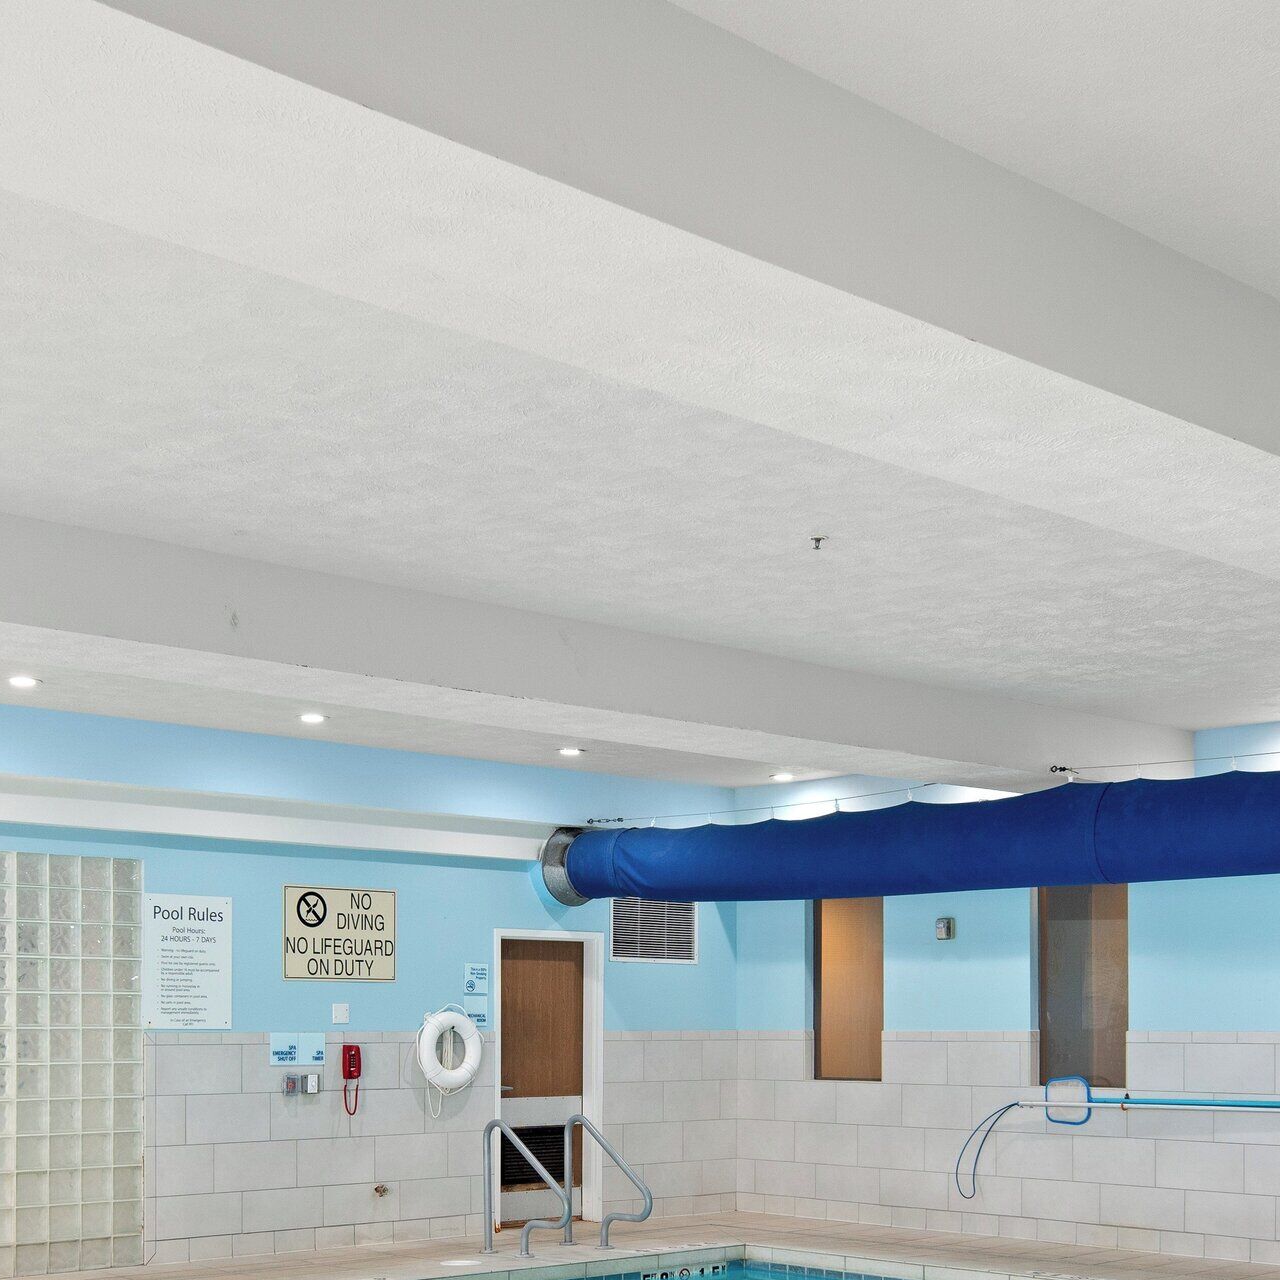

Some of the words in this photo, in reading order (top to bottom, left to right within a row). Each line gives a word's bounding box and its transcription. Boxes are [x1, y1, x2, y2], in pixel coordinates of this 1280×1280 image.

[351, 893, 371, 910] NO
[154, 906, 183, 920] Pool
[189, 907, 223, 922] Rules
[337, 913, 384, 931] DIVING
[286, 937, 308, 954] NO
[313, 938, 394, 956] LIFEGUARD
[308, 958, 329, 975] ON
[335, 959, 374, 976] DUTY
